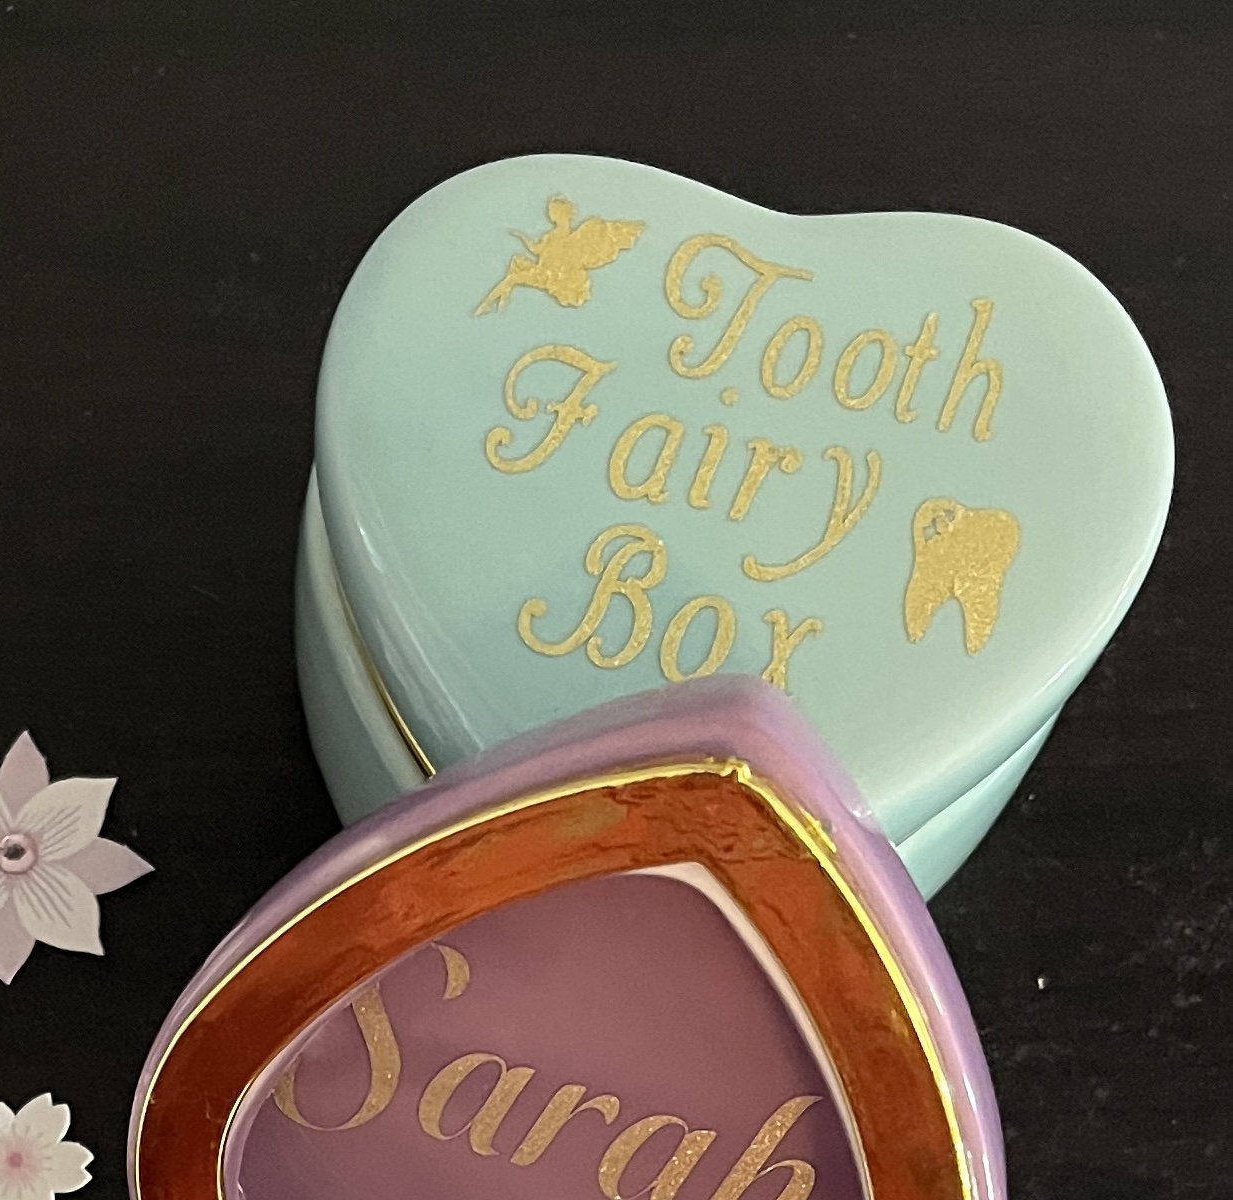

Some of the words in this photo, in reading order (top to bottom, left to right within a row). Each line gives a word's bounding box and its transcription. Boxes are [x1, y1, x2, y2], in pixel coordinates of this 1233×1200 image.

[665, 232, 1003, 442] Tooth
[484, 343, 882, 581] Fairy
[517, 523, 822, 696] Box
